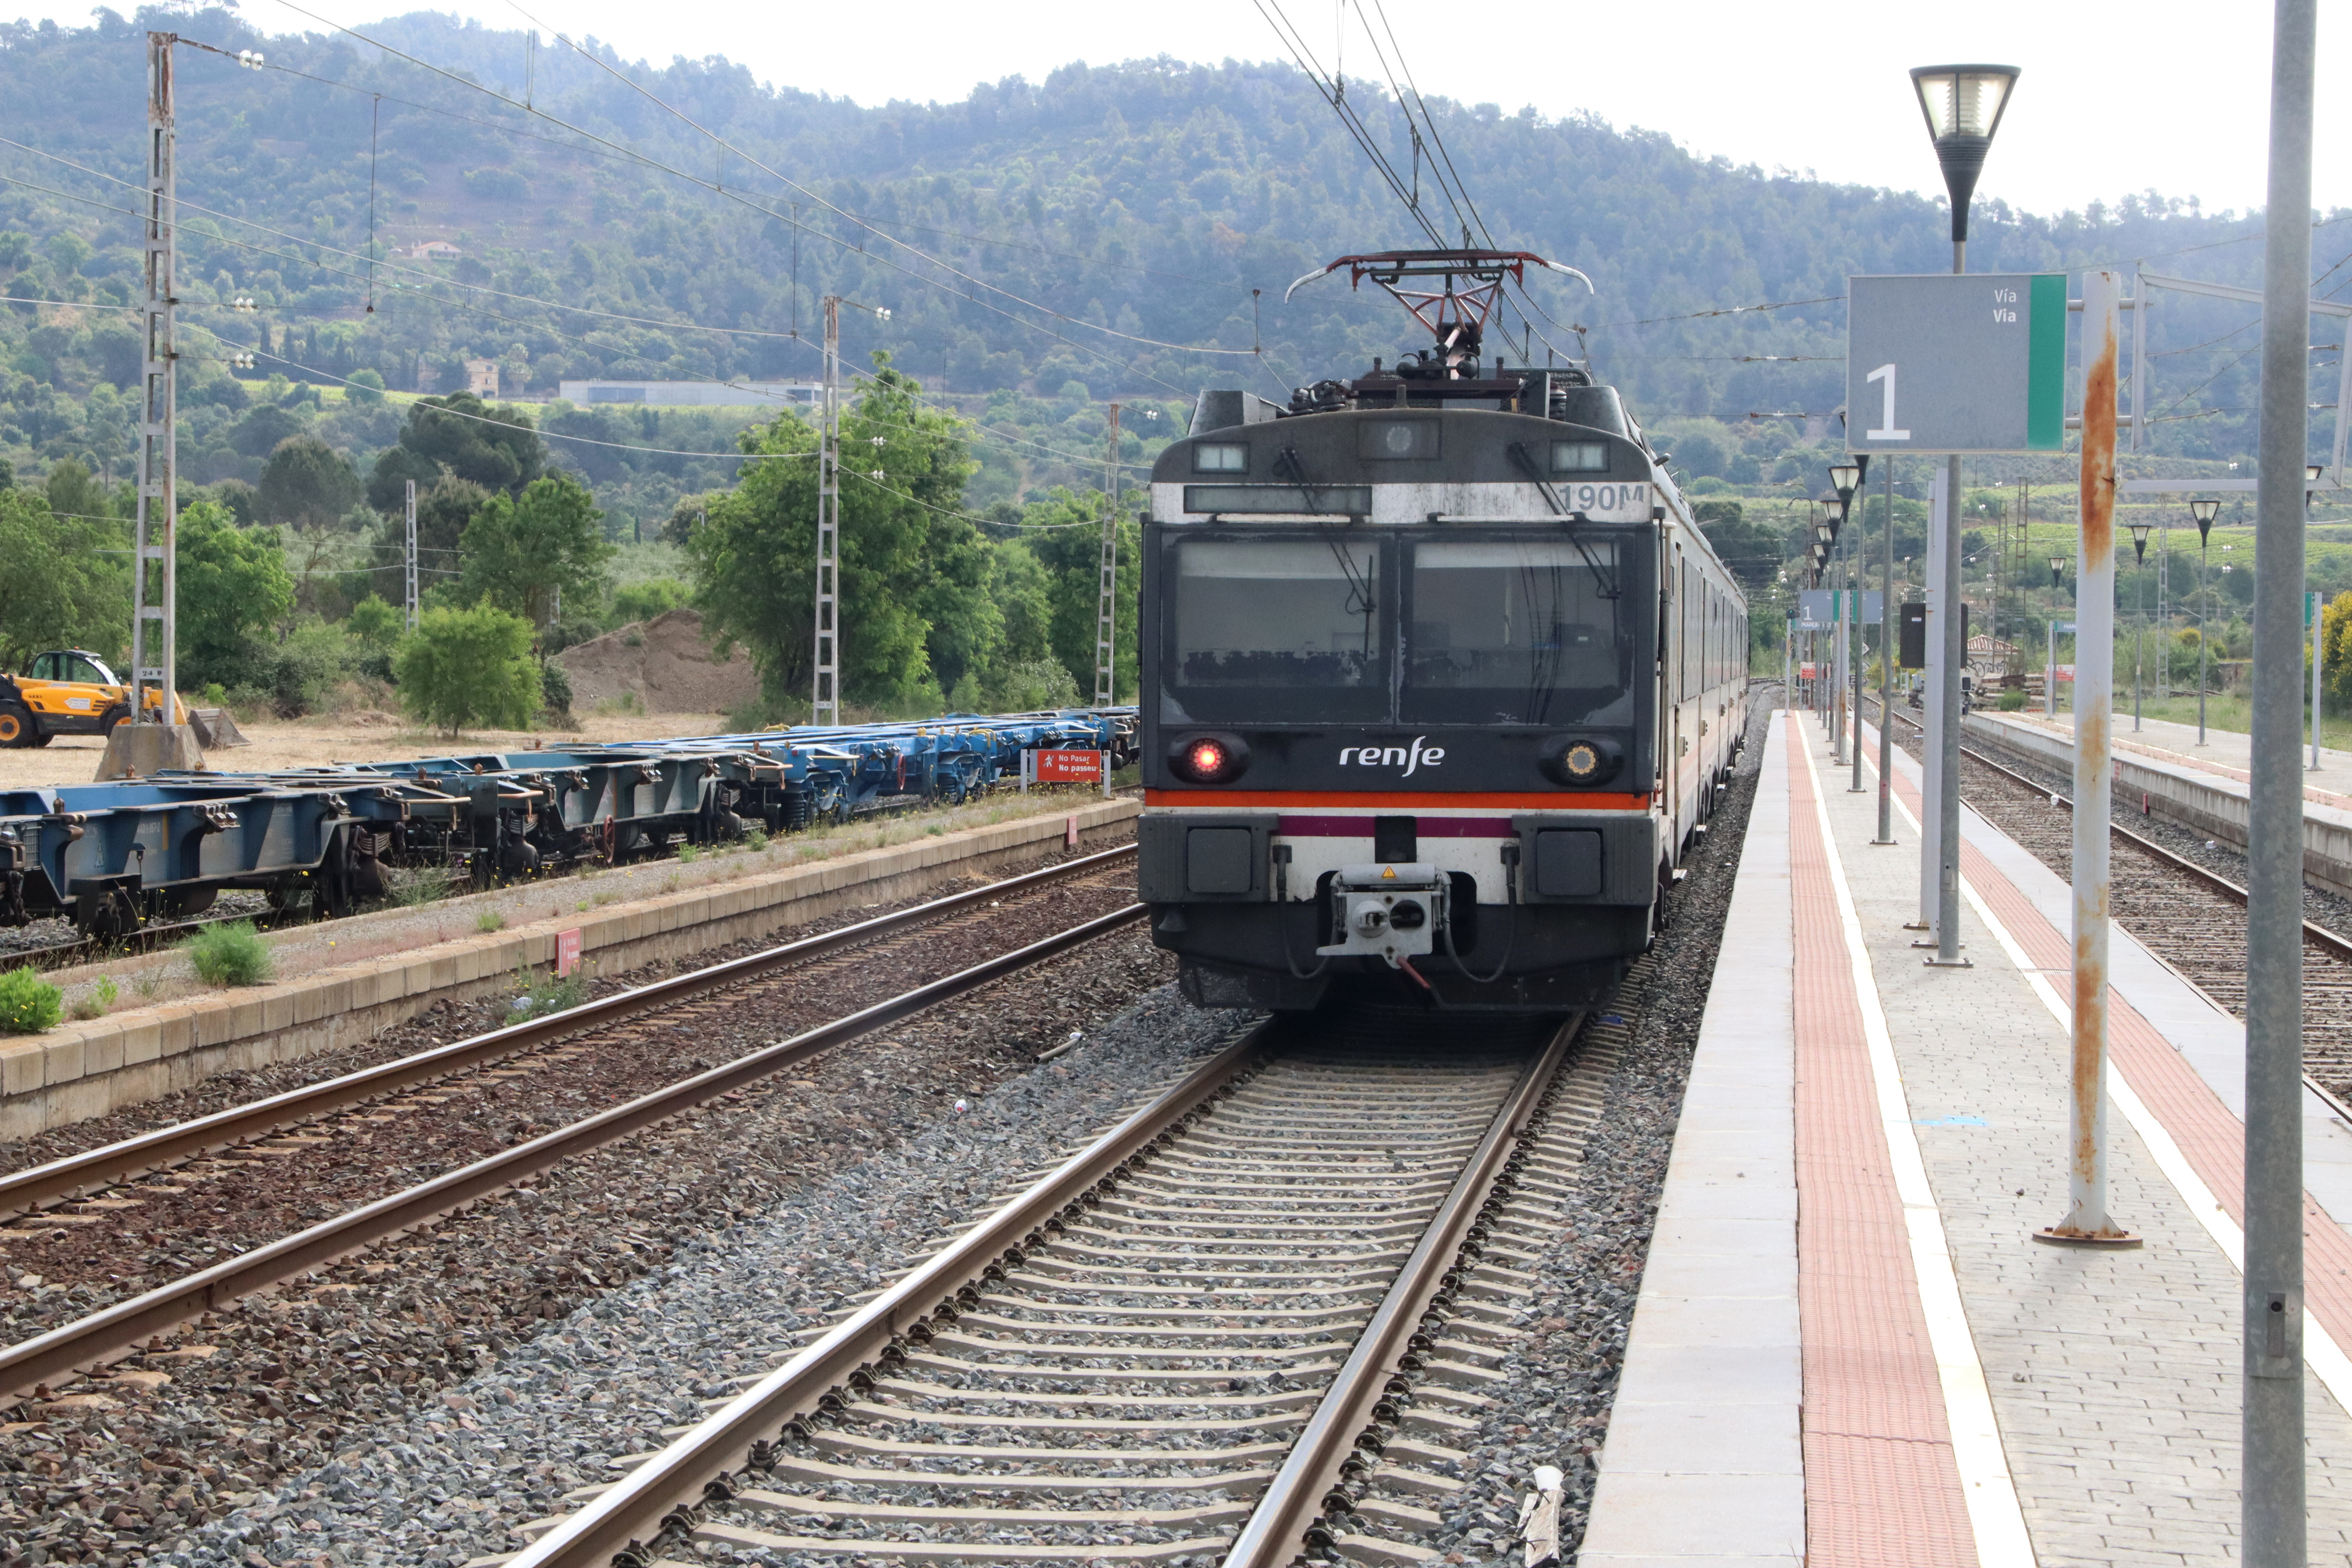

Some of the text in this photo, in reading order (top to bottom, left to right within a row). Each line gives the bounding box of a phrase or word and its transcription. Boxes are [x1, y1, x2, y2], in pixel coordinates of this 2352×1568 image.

[1995, 287, 2017, 303] Vía
[1993, 308, 2017, 323] Via
[1866, 364, 1910, 440] 1
[1559, 485, 1644, 510] 190M
[1804, 606, 1812, 620] 1
[1339, 736, 1445, 777] renfe
